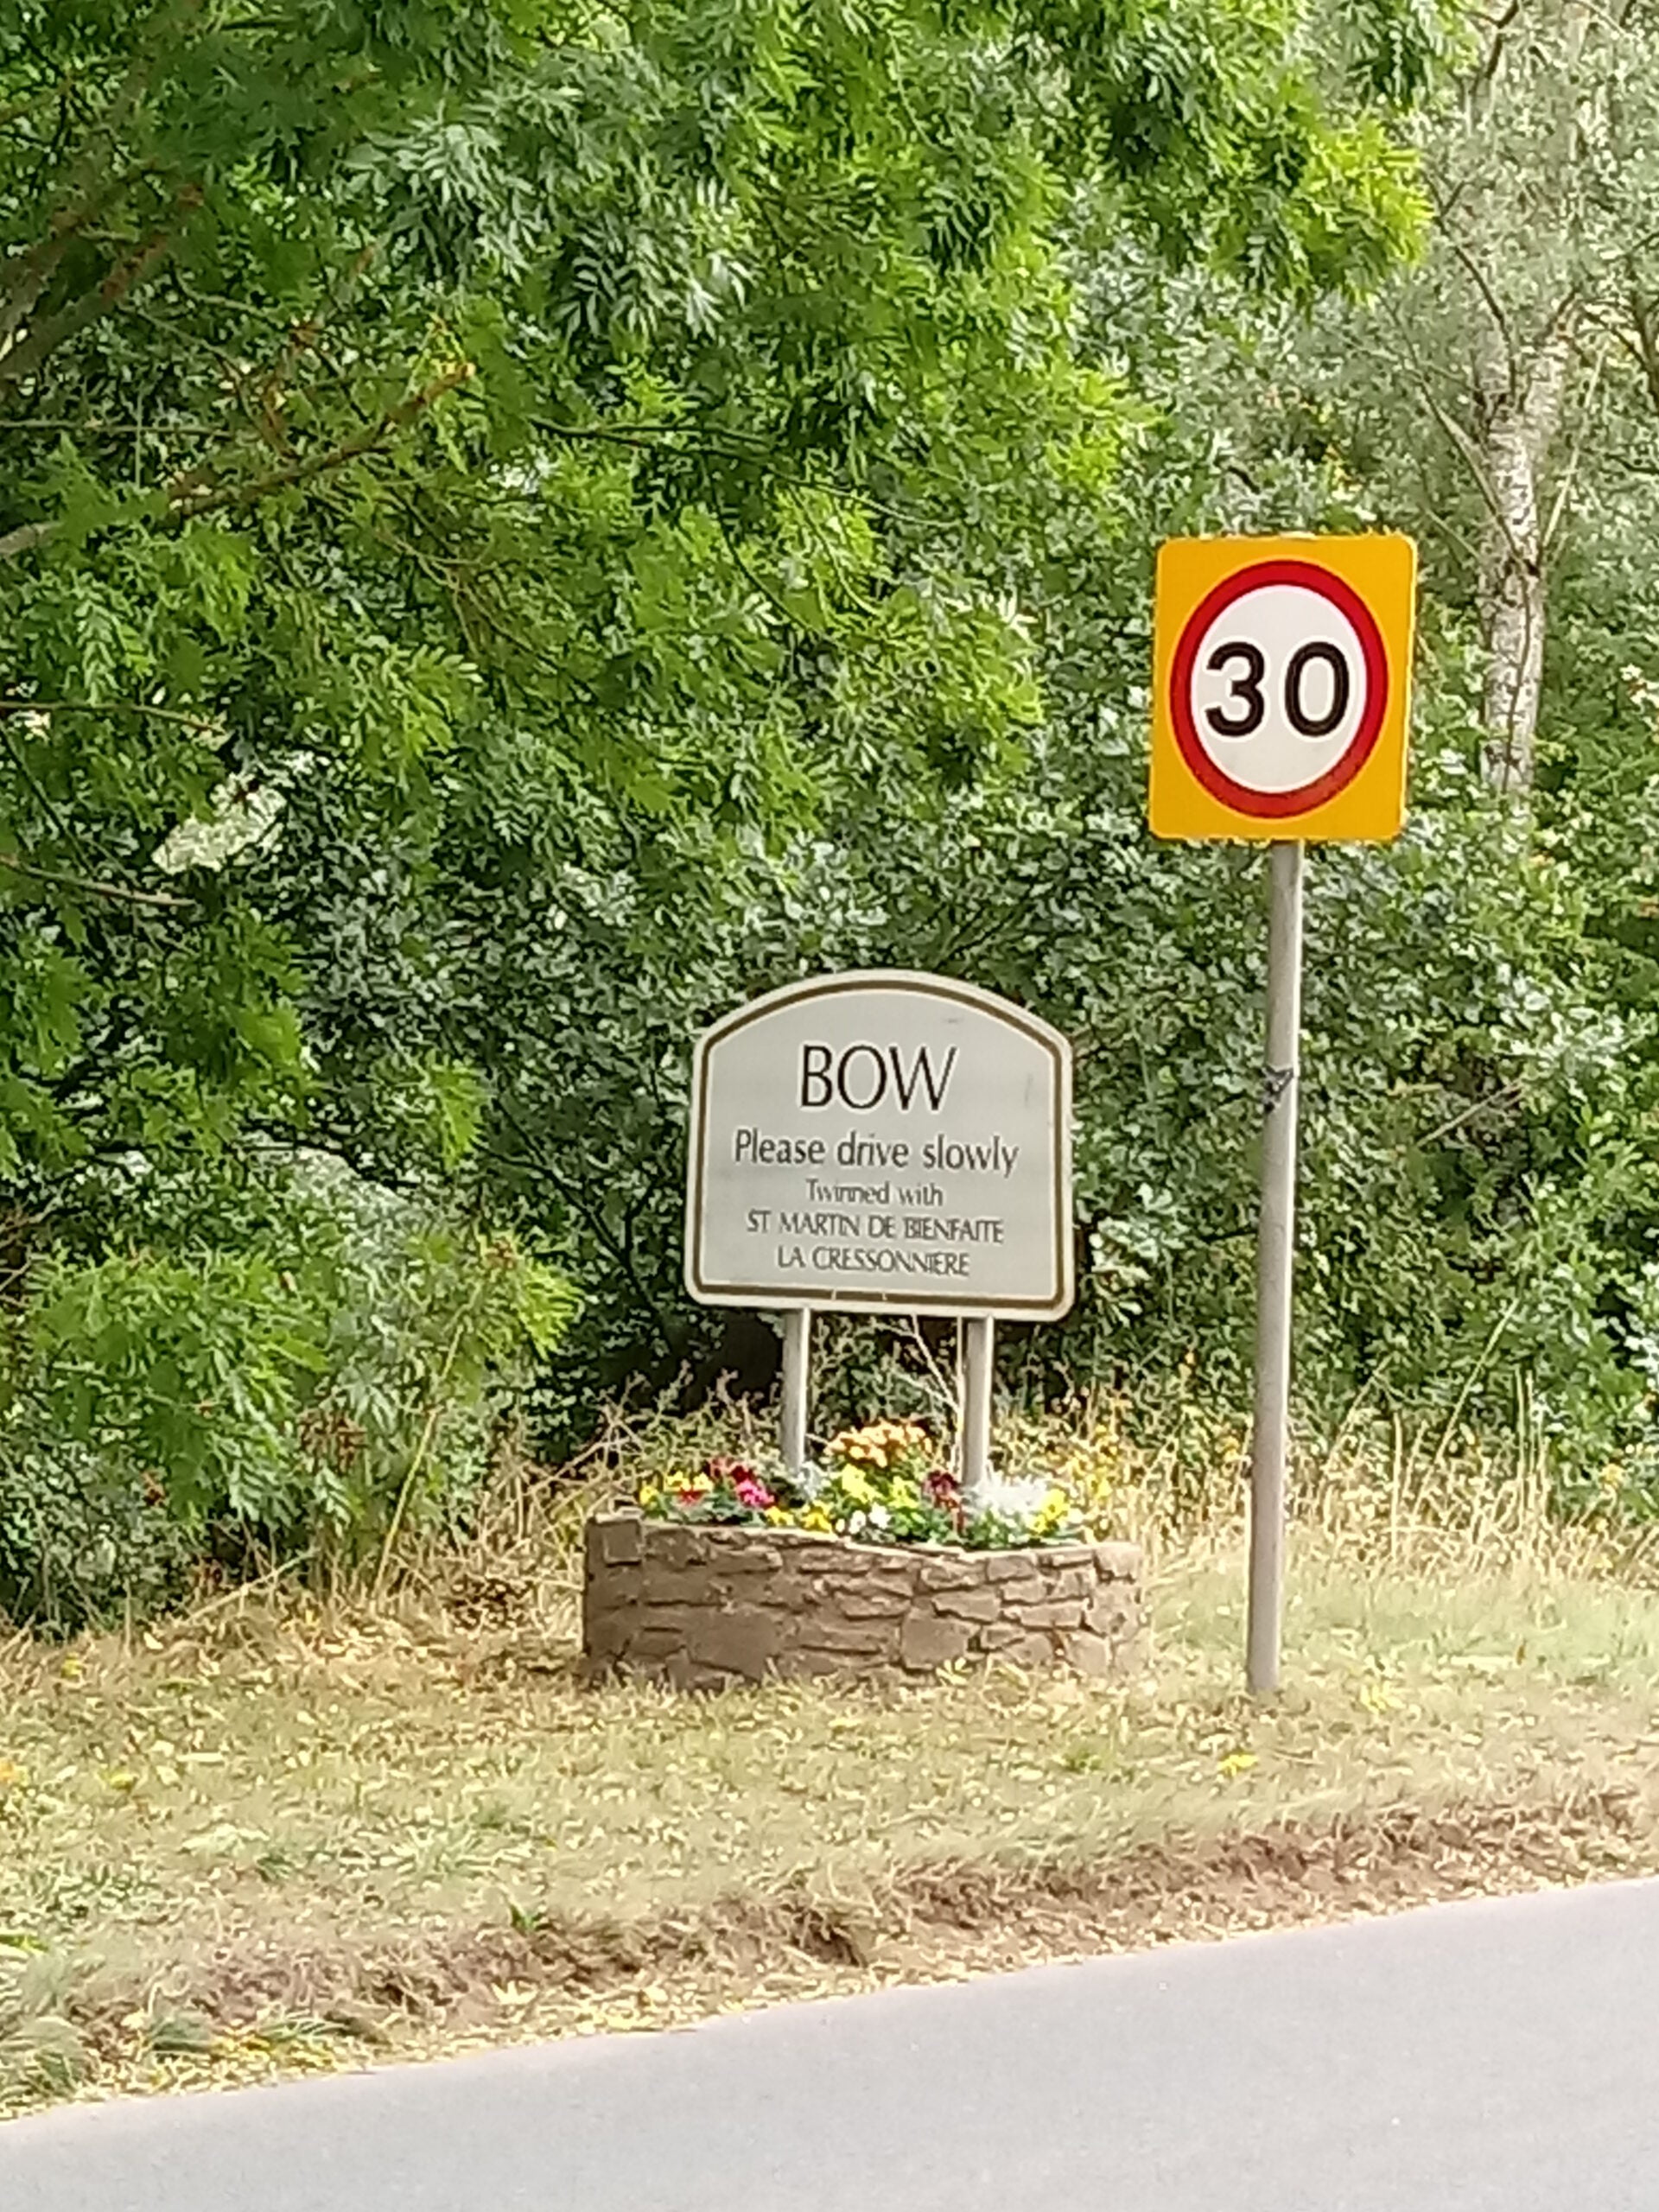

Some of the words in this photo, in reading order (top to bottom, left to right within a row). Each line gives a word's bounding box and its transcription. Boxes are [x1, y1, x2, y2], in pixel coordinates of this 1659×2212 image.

[1205, 641, 1350, 738] 30
[800, 1045, 958, 1111] BOW
[735, 1129, 826, 1165] Please
[837, 1130, 910, 1169] drive
[923, 1135, 1020, 1179] slowly
[805, 1179, 891, 1205] Twinned
[899, 1182, 944, 1206] with
[747, 1210, 772, 1233] ST
[779, 1212, 861, 1237] MARTIN
[868, 1214, 896, 1238] DE
[903, 1217, 1005, 1243] BIENFAITE
[778, 1246, 804, 1268] LA
[812, 1247, 970, 1276] CRESSONNIERE
